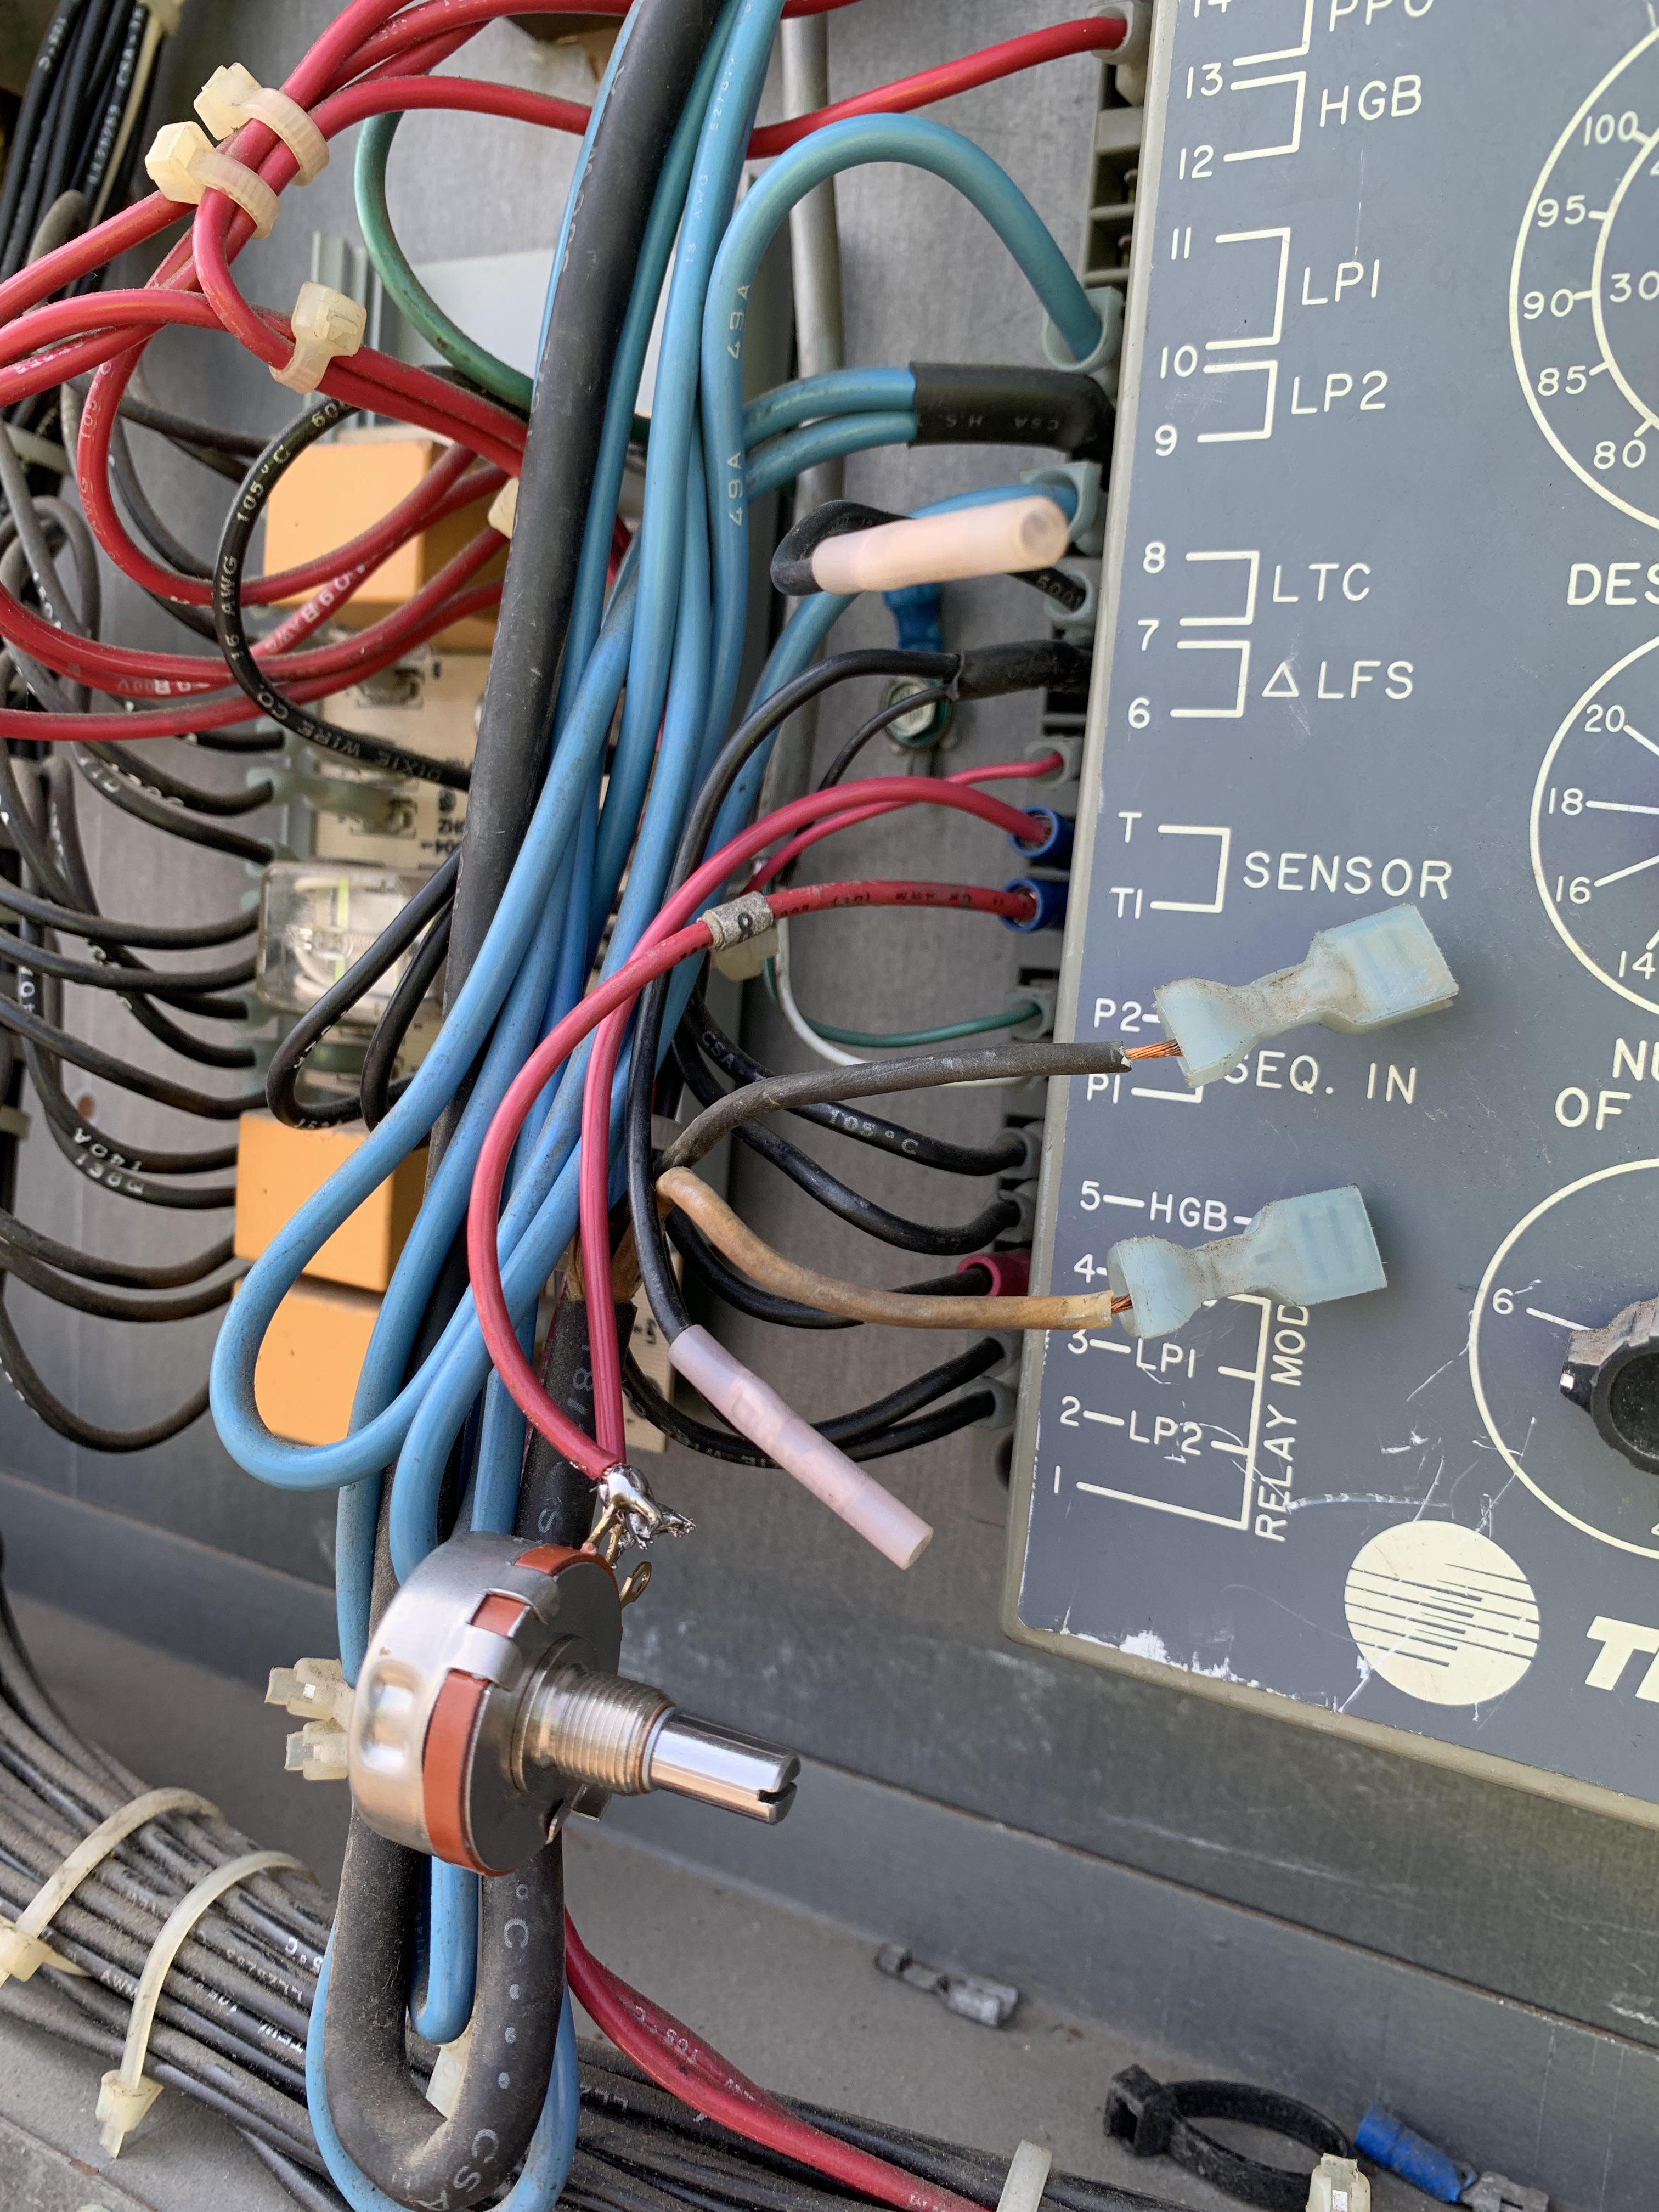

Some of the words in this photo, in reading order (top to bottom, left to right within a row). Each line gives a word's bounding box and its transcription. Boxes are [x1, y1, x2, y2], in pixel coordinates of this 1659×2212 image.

[1187, 63, 1222, 99] 13
[1320, 75, 1421, 127] HGB
[1583, 111, 1637, 145] 100
[1180, 145, 1214, 180] 12
[1537, 195, 1585, 227] 95
[1172, 227, 1191, 260] 11
[1302, 259, 1379, 305] LP1
[1523, 291, 1573, 319] 90
[1160, 346, 1197, 378] 10
[1291, 371, 1387, 414] LP2
[1538, 366, 1586, 396] 85
[1155, 425, 1177, 456] 9
[1594, 440, 1646, 469] 80
[1143, 542, 1165, 573] 8
[221, 554, 240, 616] AWG
[1273, 563, 1370, 602] LTC
[1138, 620, 1159, 651] 7
[1318, 661, 1413, 699] LFS
[1128, 697, 1150, 729] 6
[1585, 704, 1625, 732] 20
[297, 720, 362, 759] WIRE
[1549, 788, 1583, 815] 18
[1119, 812, 1142, 843] T
[1244, 851, 1451, 899] SENSOR
[1556, 876, 1590, 904] 16
[1619, 951, 1655, 979] 14
[1094, 998, 1141, 1032] P2
[702, 1029, 736, 1071] CSA
[1612, 1038, 1659, 1081] N
[1367, 1063, 1416, 1104] IN
[1555, 1087, 1631, 1130] OF
[1080, 1181, 1100, 1210] 5
[1150, 1192, 1227, 1231] HGB
[1074, 1254, 1094, 1283] 4
[1493, 1288, 1513, 1314] 6
[1068, 1328, 1088, 1353] 3
[1060, 1396, 1080, 1426] 2
[1130, 1410, 1202, 1455] LP2
[1054, 1466, 1060, 1493] 1
[1255, 1404, 1297, 1541] RELAY
[1585, 1616, 1659, 1703] T
